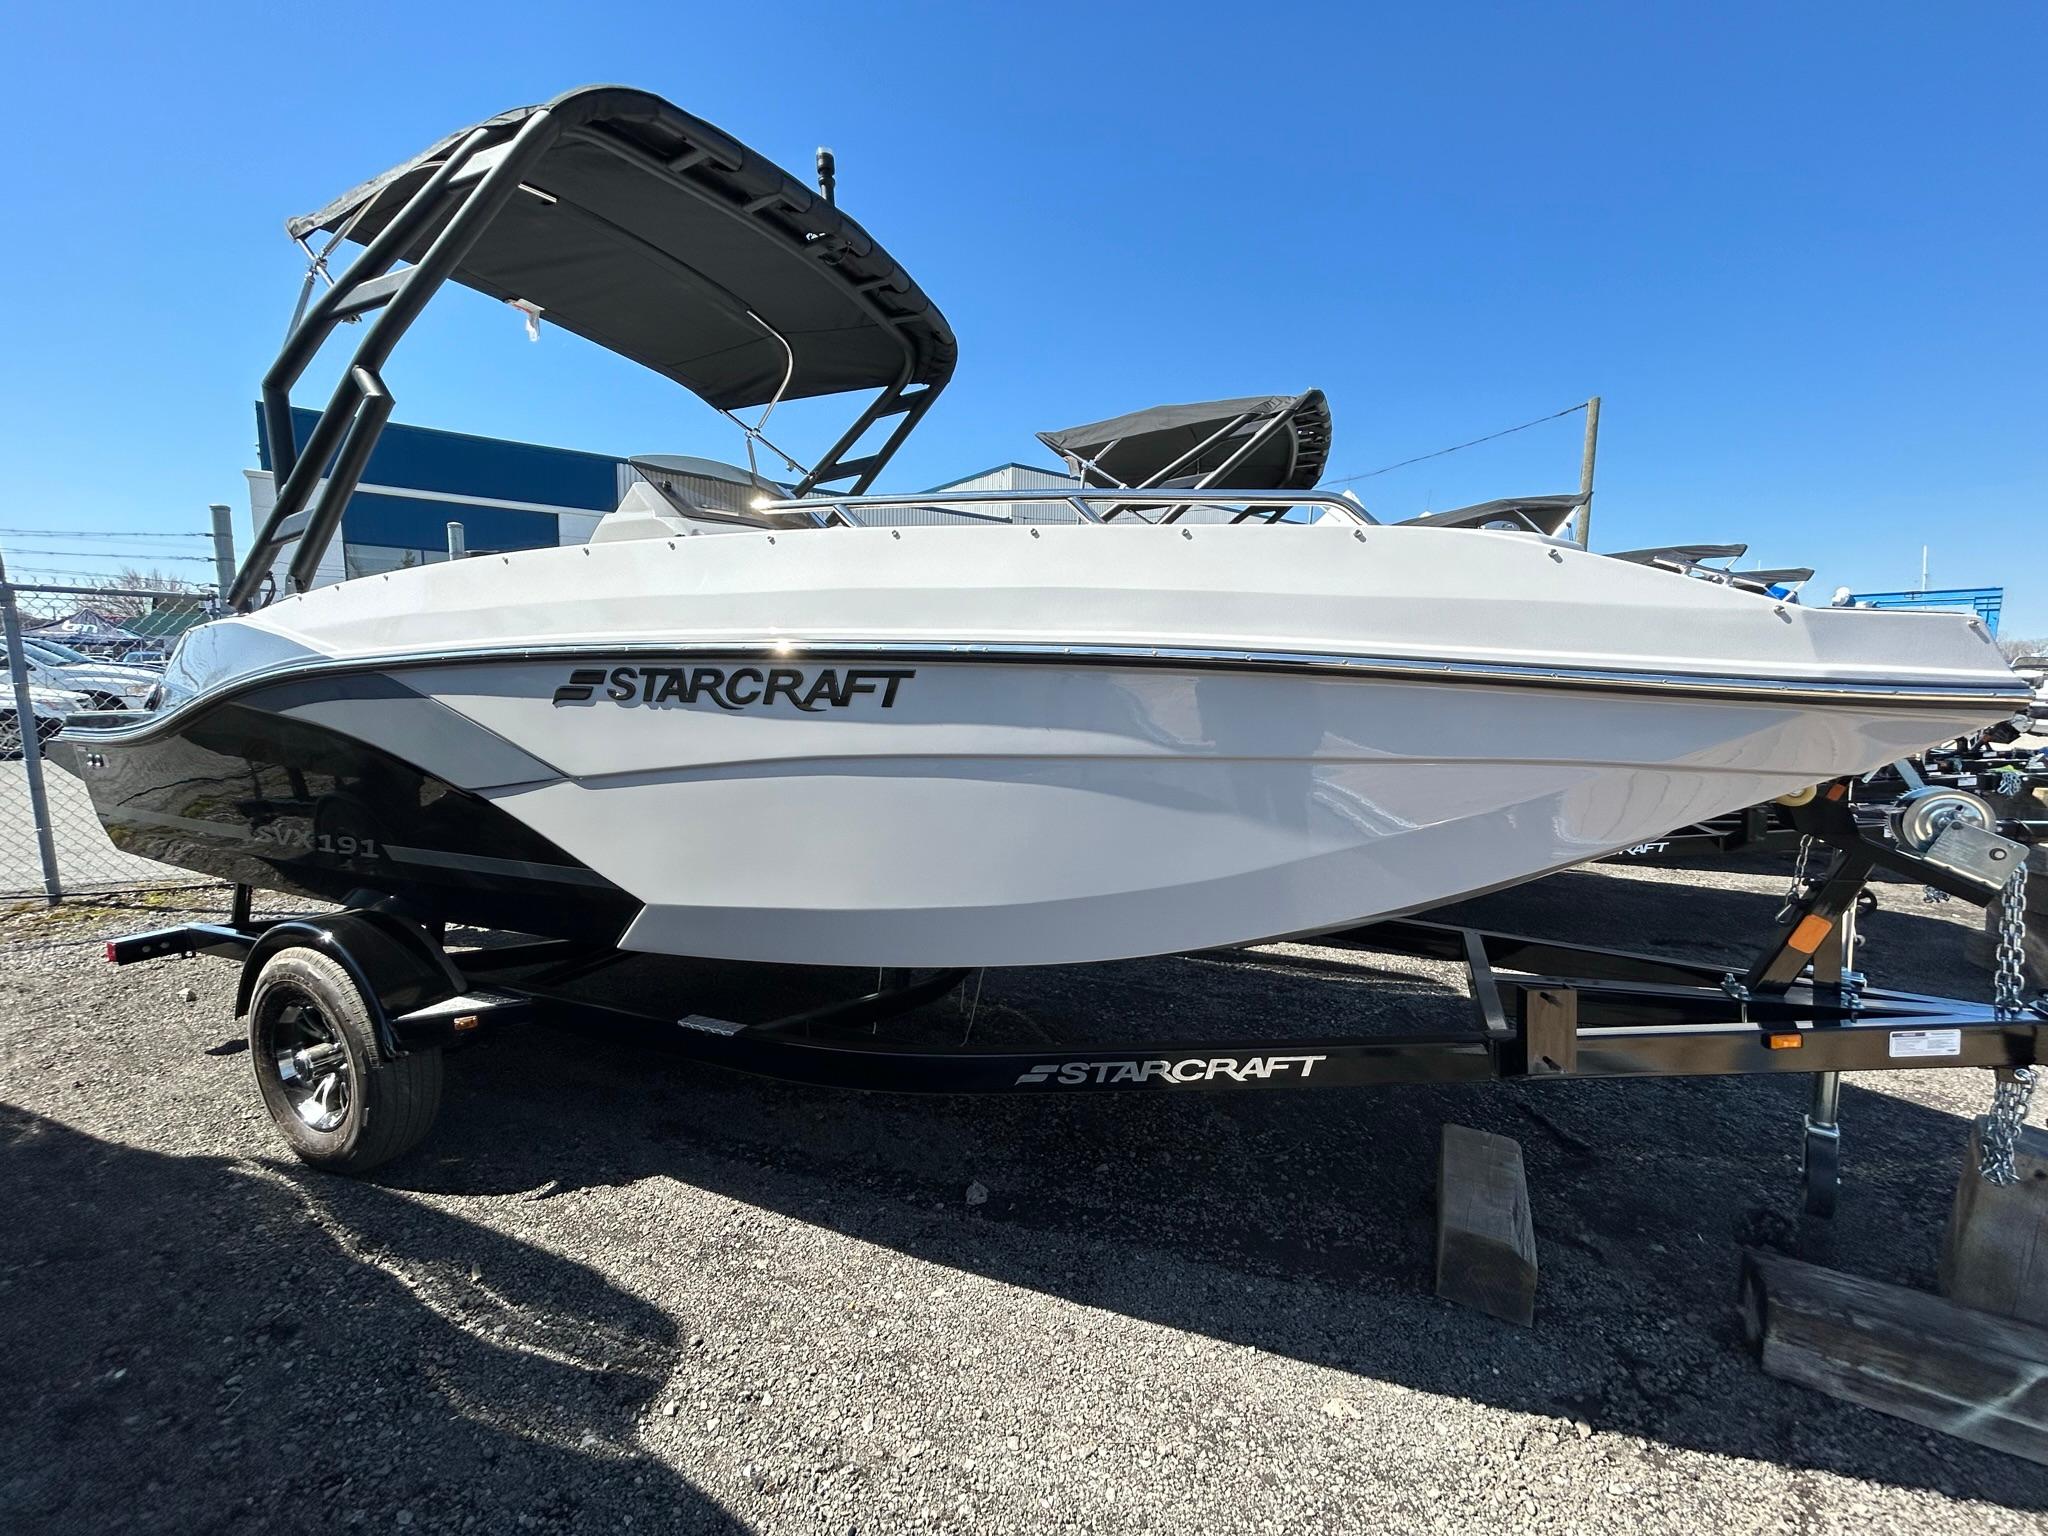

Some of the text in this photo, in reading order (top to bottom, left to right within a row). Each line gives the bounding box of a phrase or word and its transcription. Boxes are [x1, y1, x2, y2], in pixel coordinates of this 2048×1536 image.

[607, 667, 916, 711] STARCRAFT
[318, 834, 380, 859] 191
[1057, 1055, 1327, 1084] STARCRAFT
